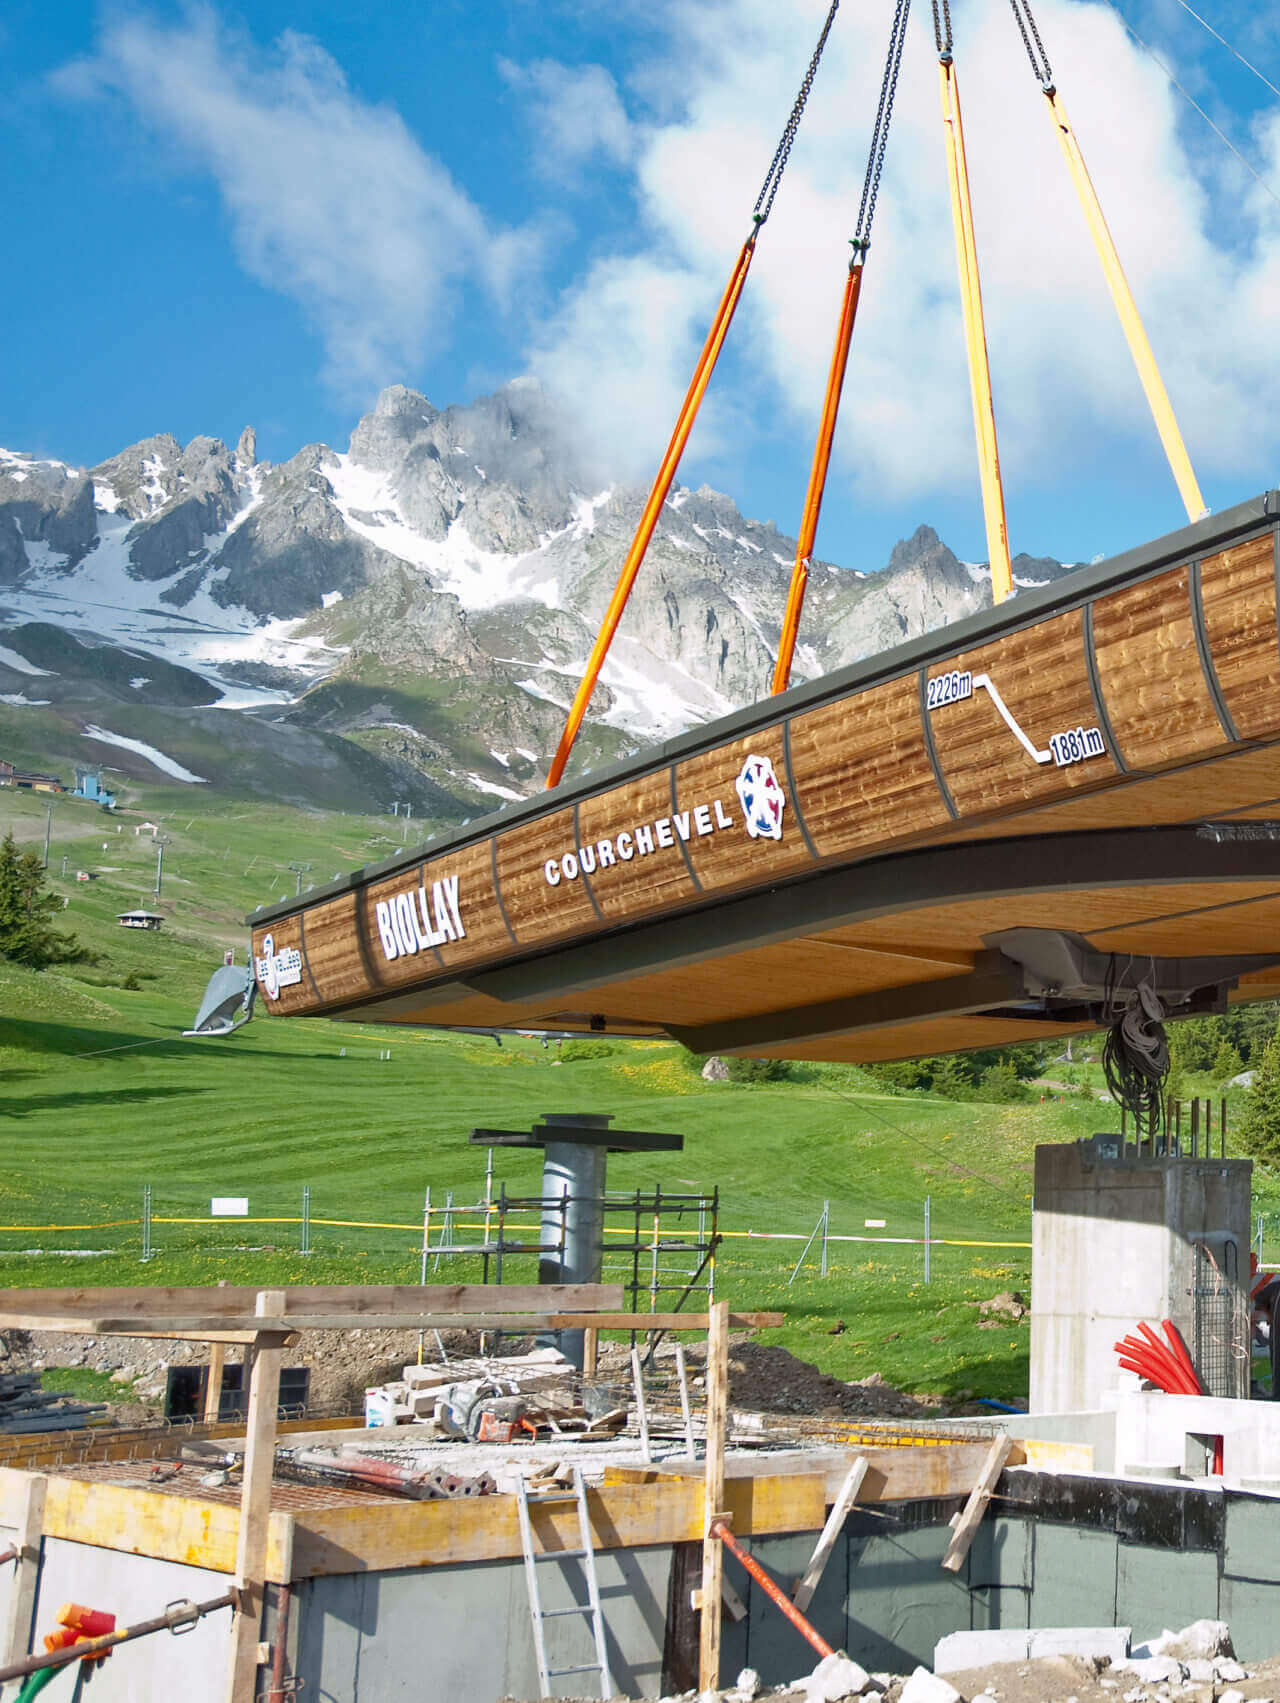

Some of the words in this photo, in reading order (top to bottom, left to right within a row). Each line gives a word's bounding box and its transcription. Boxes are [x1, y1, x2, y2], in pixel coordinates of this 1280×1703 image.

[929, 674, 970, 706] 2226m
[1051, 729, 1103, 763] 1881m
[544, 800, 733, 886] COURCHEVEL
[375, 875, 465, 960] BIOLLAY
